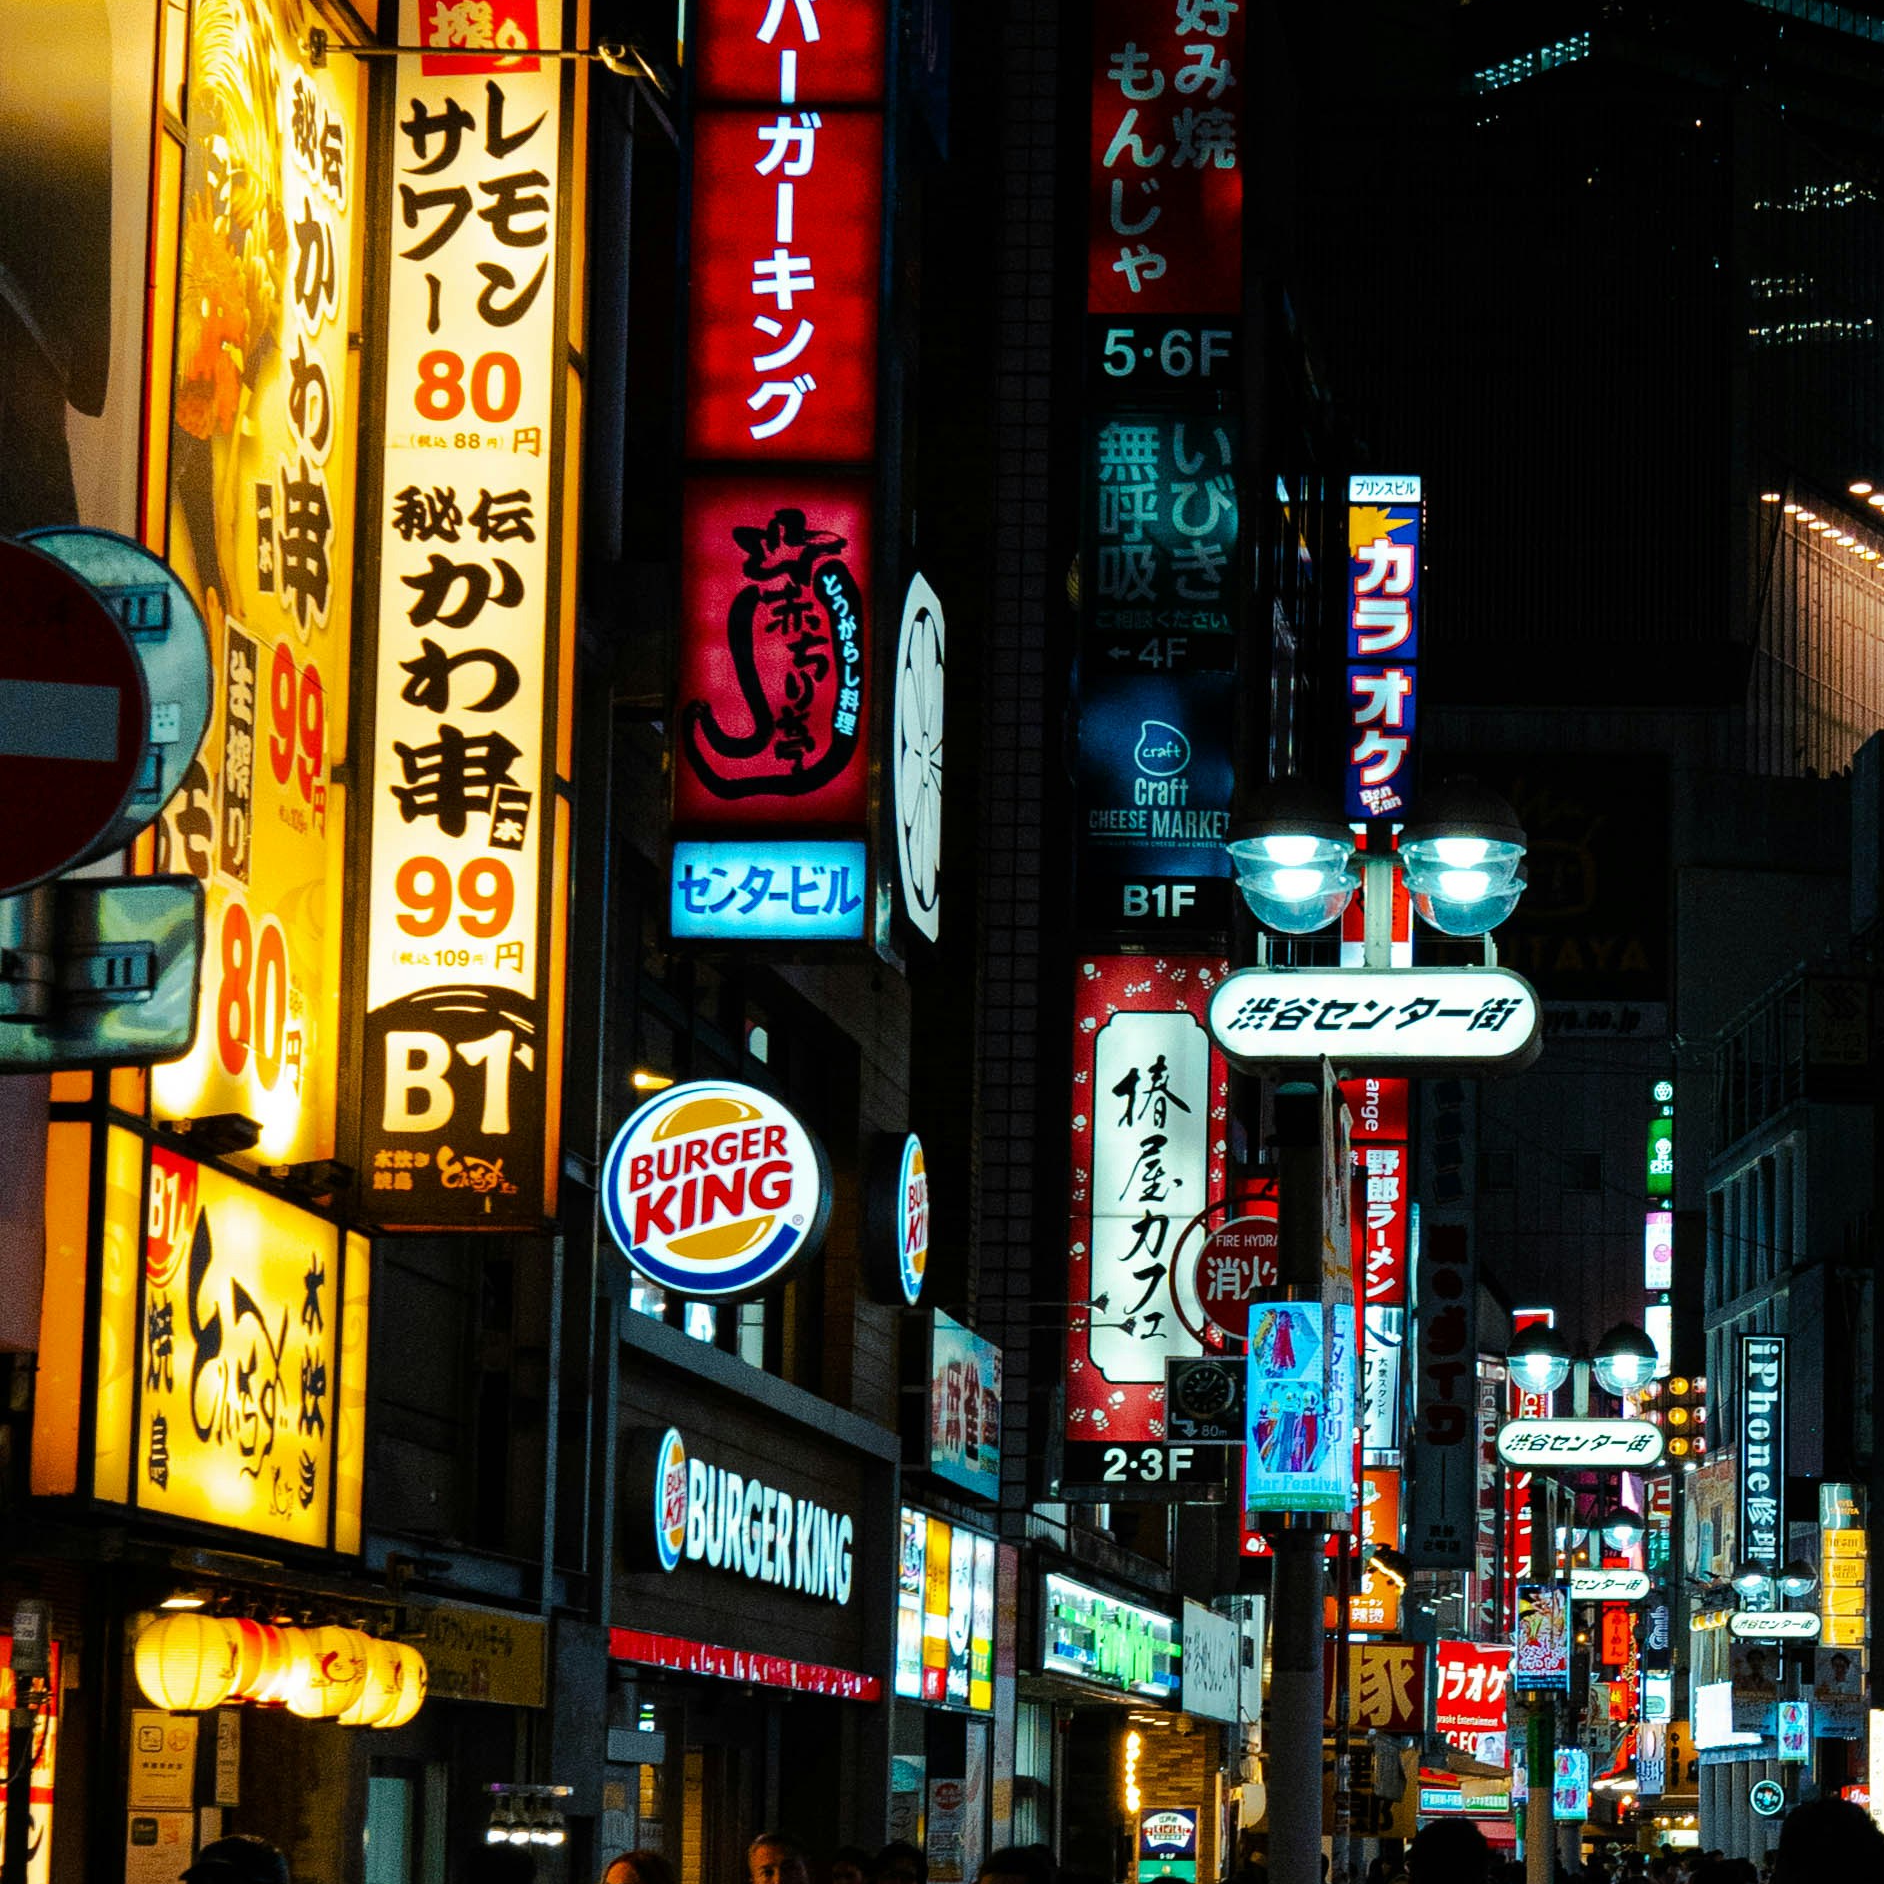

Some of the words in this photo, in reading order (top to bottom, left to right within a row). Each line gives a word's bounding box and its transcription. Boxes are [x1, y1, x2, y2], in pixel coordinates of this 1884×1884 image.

[478, 79, 551, 328] レモン
[1103, 42, 1168, 293] もんじゃ
[399, 96, 476, 335] サワー
[414, 349, 522, 423] 80
[392, 484, 537, 544] 秘伝
[1099, 427, 1158, 600] 無呼吸
[1355, 480, 1415, 496] プリンスビル
[821, 572, 863, 737] とうがらし料理
[1138, 638, 1188, 668] 4F
[1352, 538, 1412, 785] カラオケ
[269, 642, 325, 805] 99
[392, 553, 526, 838] かわ串
[1089, 810, 1147, 829] CHEESE
[1134, 778, 1189, 805] Craft
[395, 856, 515, 938] 99
[677, 863, 863, 917] センタービル
[1123, 886, 1196, 917] B1F
[494, 941, 524, 973] 円
[218, 903, 286, 1092] 80
[1227, 997, 1524, 1032] 渋谷センター街
[382, 1030, 514, 1135] B1
[628, 1124, 787, 1193] BURGER
[1111, 1054, 1191, 1341] 椿屋カフェ
[149, 1165, 179, 1245] B1
[632, 1162, 792, 1245] KING
[1216, 1235, 1240, 1247] FIRE
[1366, 1149, 1400, 1297] 野郎ラーメン
[1202, 1425, 1227, 1437] 80m
[1505, 1433, 1654, 1452] 渋谷センター街
[687, 1459, 791, 1587] BURGER
[795, 1499, 852, 1604] KING
[1735, 1619, 1815, 1631] 渋谷センター街
